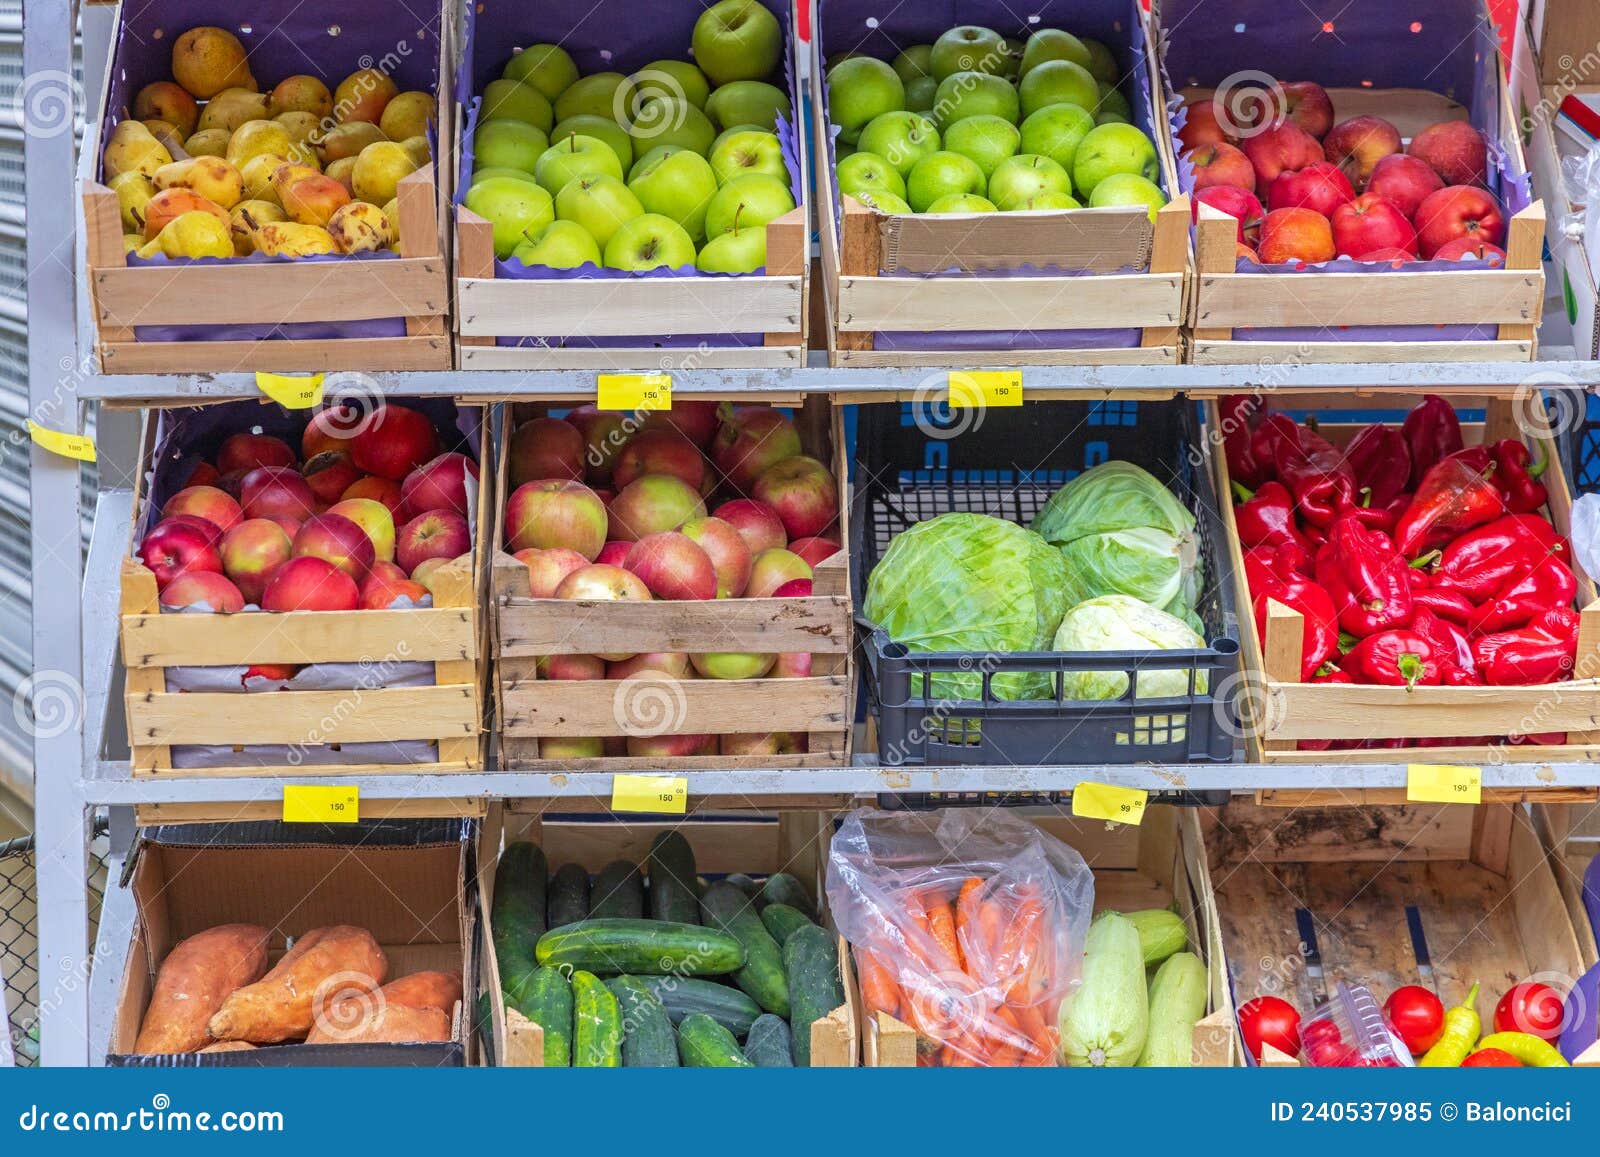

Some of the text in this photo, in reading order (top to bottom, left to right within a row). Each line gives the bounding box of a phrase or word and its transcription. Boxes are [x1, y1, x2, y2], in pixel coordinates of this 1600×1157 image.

[643, 391, 658, 399] 150
[1453, 784, 1468, 792] 190
[658, 794, 673, 802] 150
[330, 803, 345, 811] 150
[1120, 804, 1131, 813] 99
